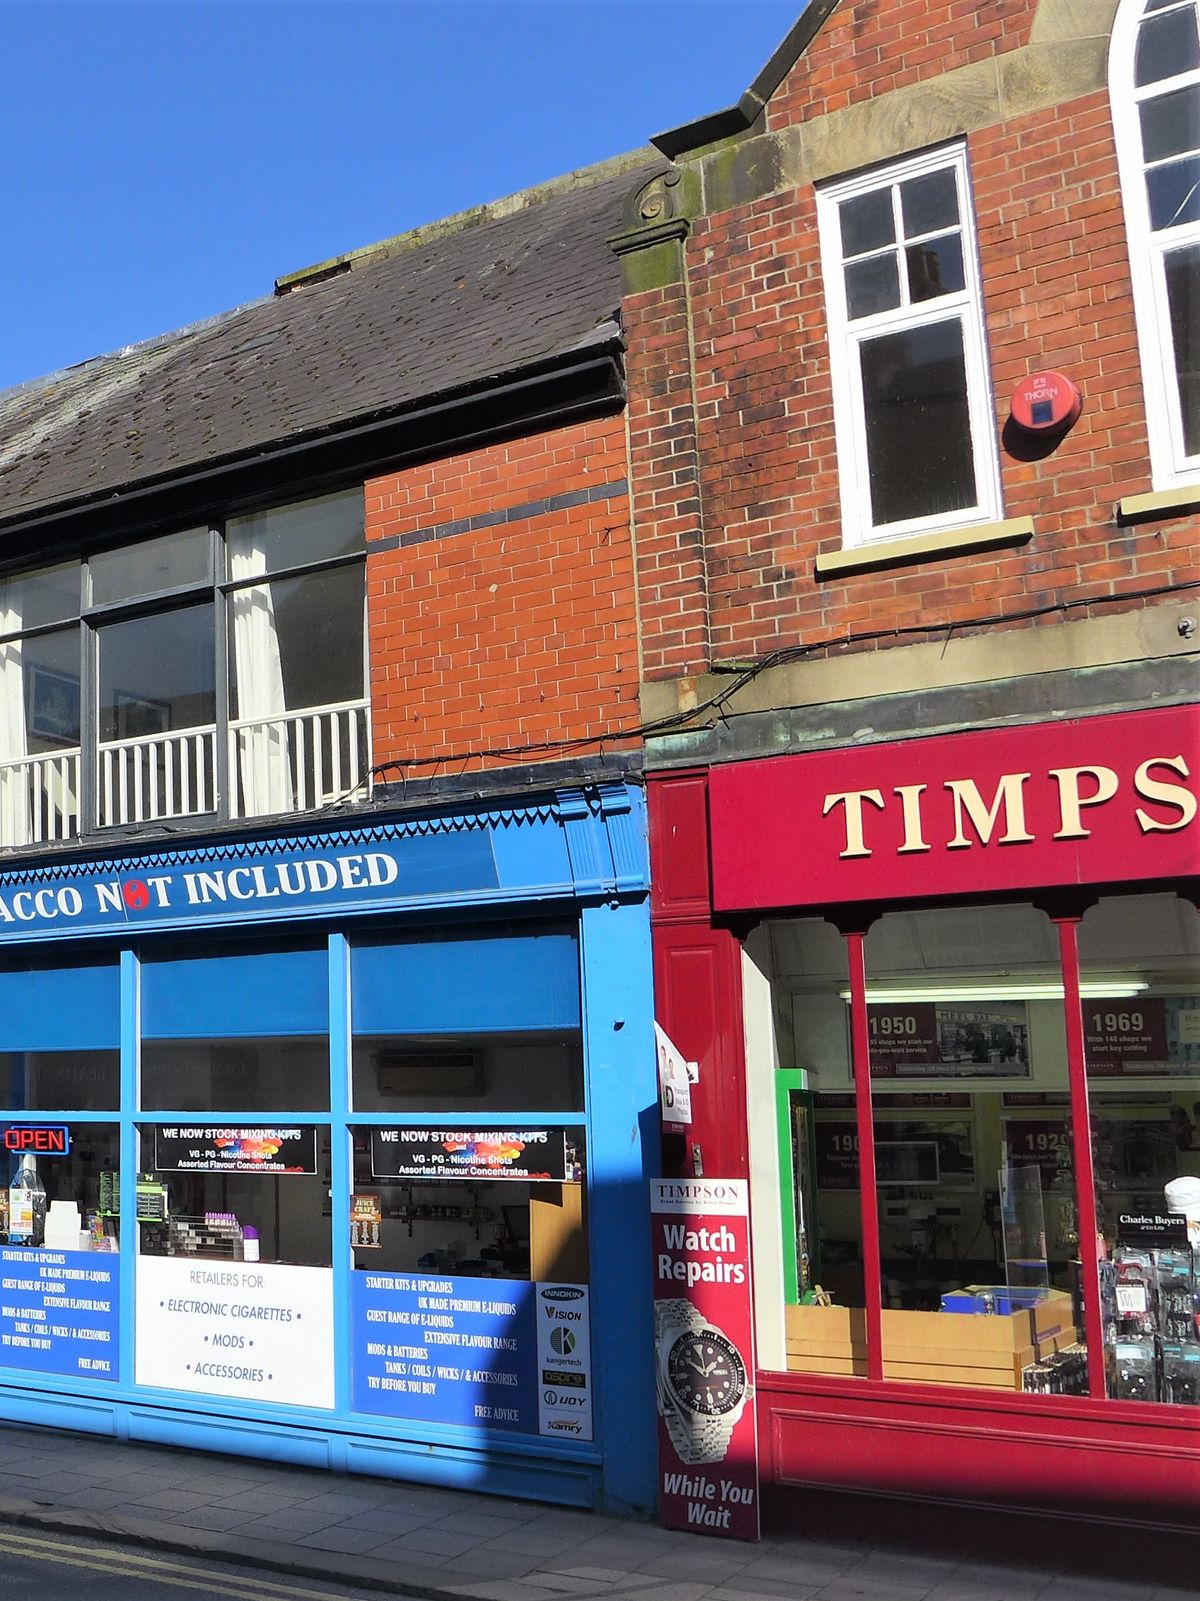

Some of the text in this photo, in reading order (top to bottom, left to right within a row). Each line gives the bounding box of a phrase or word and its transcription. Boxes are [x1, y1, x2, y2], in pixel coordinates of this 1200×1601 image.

[1024, 387, 1058, 400] THORN
[822, 755, 1198, 857] TIMPS
[99, 875, 173, 913] NOT
[182, 853, 399, 905] INCLUDED
[869, 1017, 916, 1035] 1950
[1092, 1013, 1143, 1032] 1969
[1110, 1045, 1121, 1053] key
[1123, 1044, 1147, 1052] cutting
[5, 1129, 64, 1150] OPEN
[163, 1129, 301, 1140] WE NOW STOCK MIXING KITS
[381, 1131, 548, 1143] WE NOW STOCK MIXING KITS
[189, 1150, 272, 1159] VG PG Nicotine Shots
[412, 1154, 513, 1165] VG PG Nicotine Shots
[178, 1160, 285, 1170] Assorted Flavour Concentrates
[399, 1165, 528, 1176] Assorted Flavour Concentrates
[657, 1185, 738, 1198] TIMPSON
[1120, 1215, 1185, 1227] Charles Buyers
[663, 1224, 736, 1252] Watch
[35, 1253, 39, 1262] &
[40, 1254, 65, 1264] UPGRADES
[40, 1267, 110, 1283] UK MADE PREMIUM E-LIQUIDS
[658, 1254, 745, 1287] Repairs
[2, 1278, 65, 1293] GUEST RANGE OF E-LIQUIDS
[190, 1271, 239, 1287] RETAILERS
[366, 1277, 453, 1293] STARTER KITS & UPGRADES
[544, 1290, 582, 1298] INNOKIN
[44, 1296, 111, 1312] EXTENSIVE FLAVOUR RANGE
[168, 1299, 292, 1322] ELECTRONIC CIGARETTES
[419, 1297, 516, 1315] UK MADE PREMIUM E-LIQUIDS
[2, 1307, 46, 1320] MODS & BATTERIES
[367, 1310, 454, 1328] GUEST RANGE OF E-LIQUIDS
[15, 1322, 30, 1333] TANKS
[34, 1324, 48, 1334] COILS
[52, 1326, 68, 1337] WICKS
[78, 1329, 110, 1342] ACCESSORIES
[2, 1335, 52, 1350] TRY BEFORE YOU BUY
[212, 1333, 245, 1349] MODS
[425, 1331, 518, 1351] EXTENSIVE FLAVOUR RANGE
[368, 1343, 428, 1360] MODS & BATTERIES
[78, 1358, 110, 1370] FREE ADVICE
[546, 1357, 582, 1367] kangertech
[194, 1362, 263, 1382] ACCESSORIES
[385, 1361, 518, 1386] TANKS COILS WICKS & ACCESSORIES
[544, 1372, 582, 1384] aspire
[368, 1376, 436, 1395] TRY BEFORE YOU BUY
[475, 1405, 519, 1421] FREE ADVICE
[664, 1472, 753, 1505] While You
[687, 1501, 731, 1529] Wait
